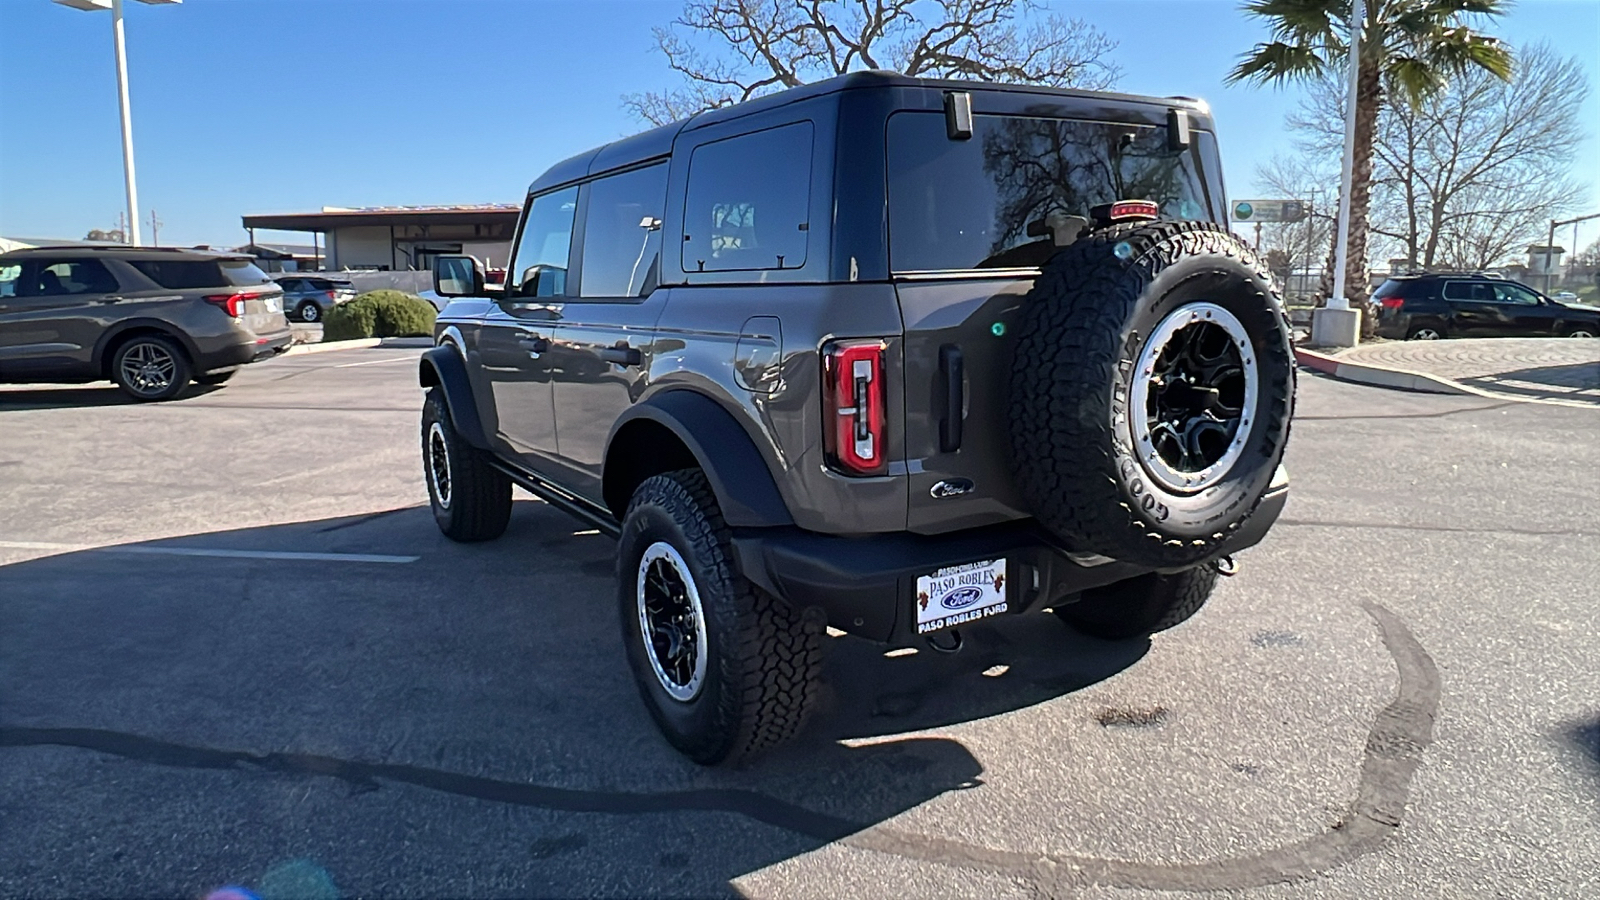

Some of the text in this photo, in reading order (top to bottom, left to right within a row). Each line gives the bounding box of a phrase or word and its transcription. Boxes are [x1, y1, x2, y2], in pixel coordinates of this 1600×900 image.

[929, 569, 995, 599] PASO ROBLES
[918, 603, 1008, 635] PASO ROBLES FORD
